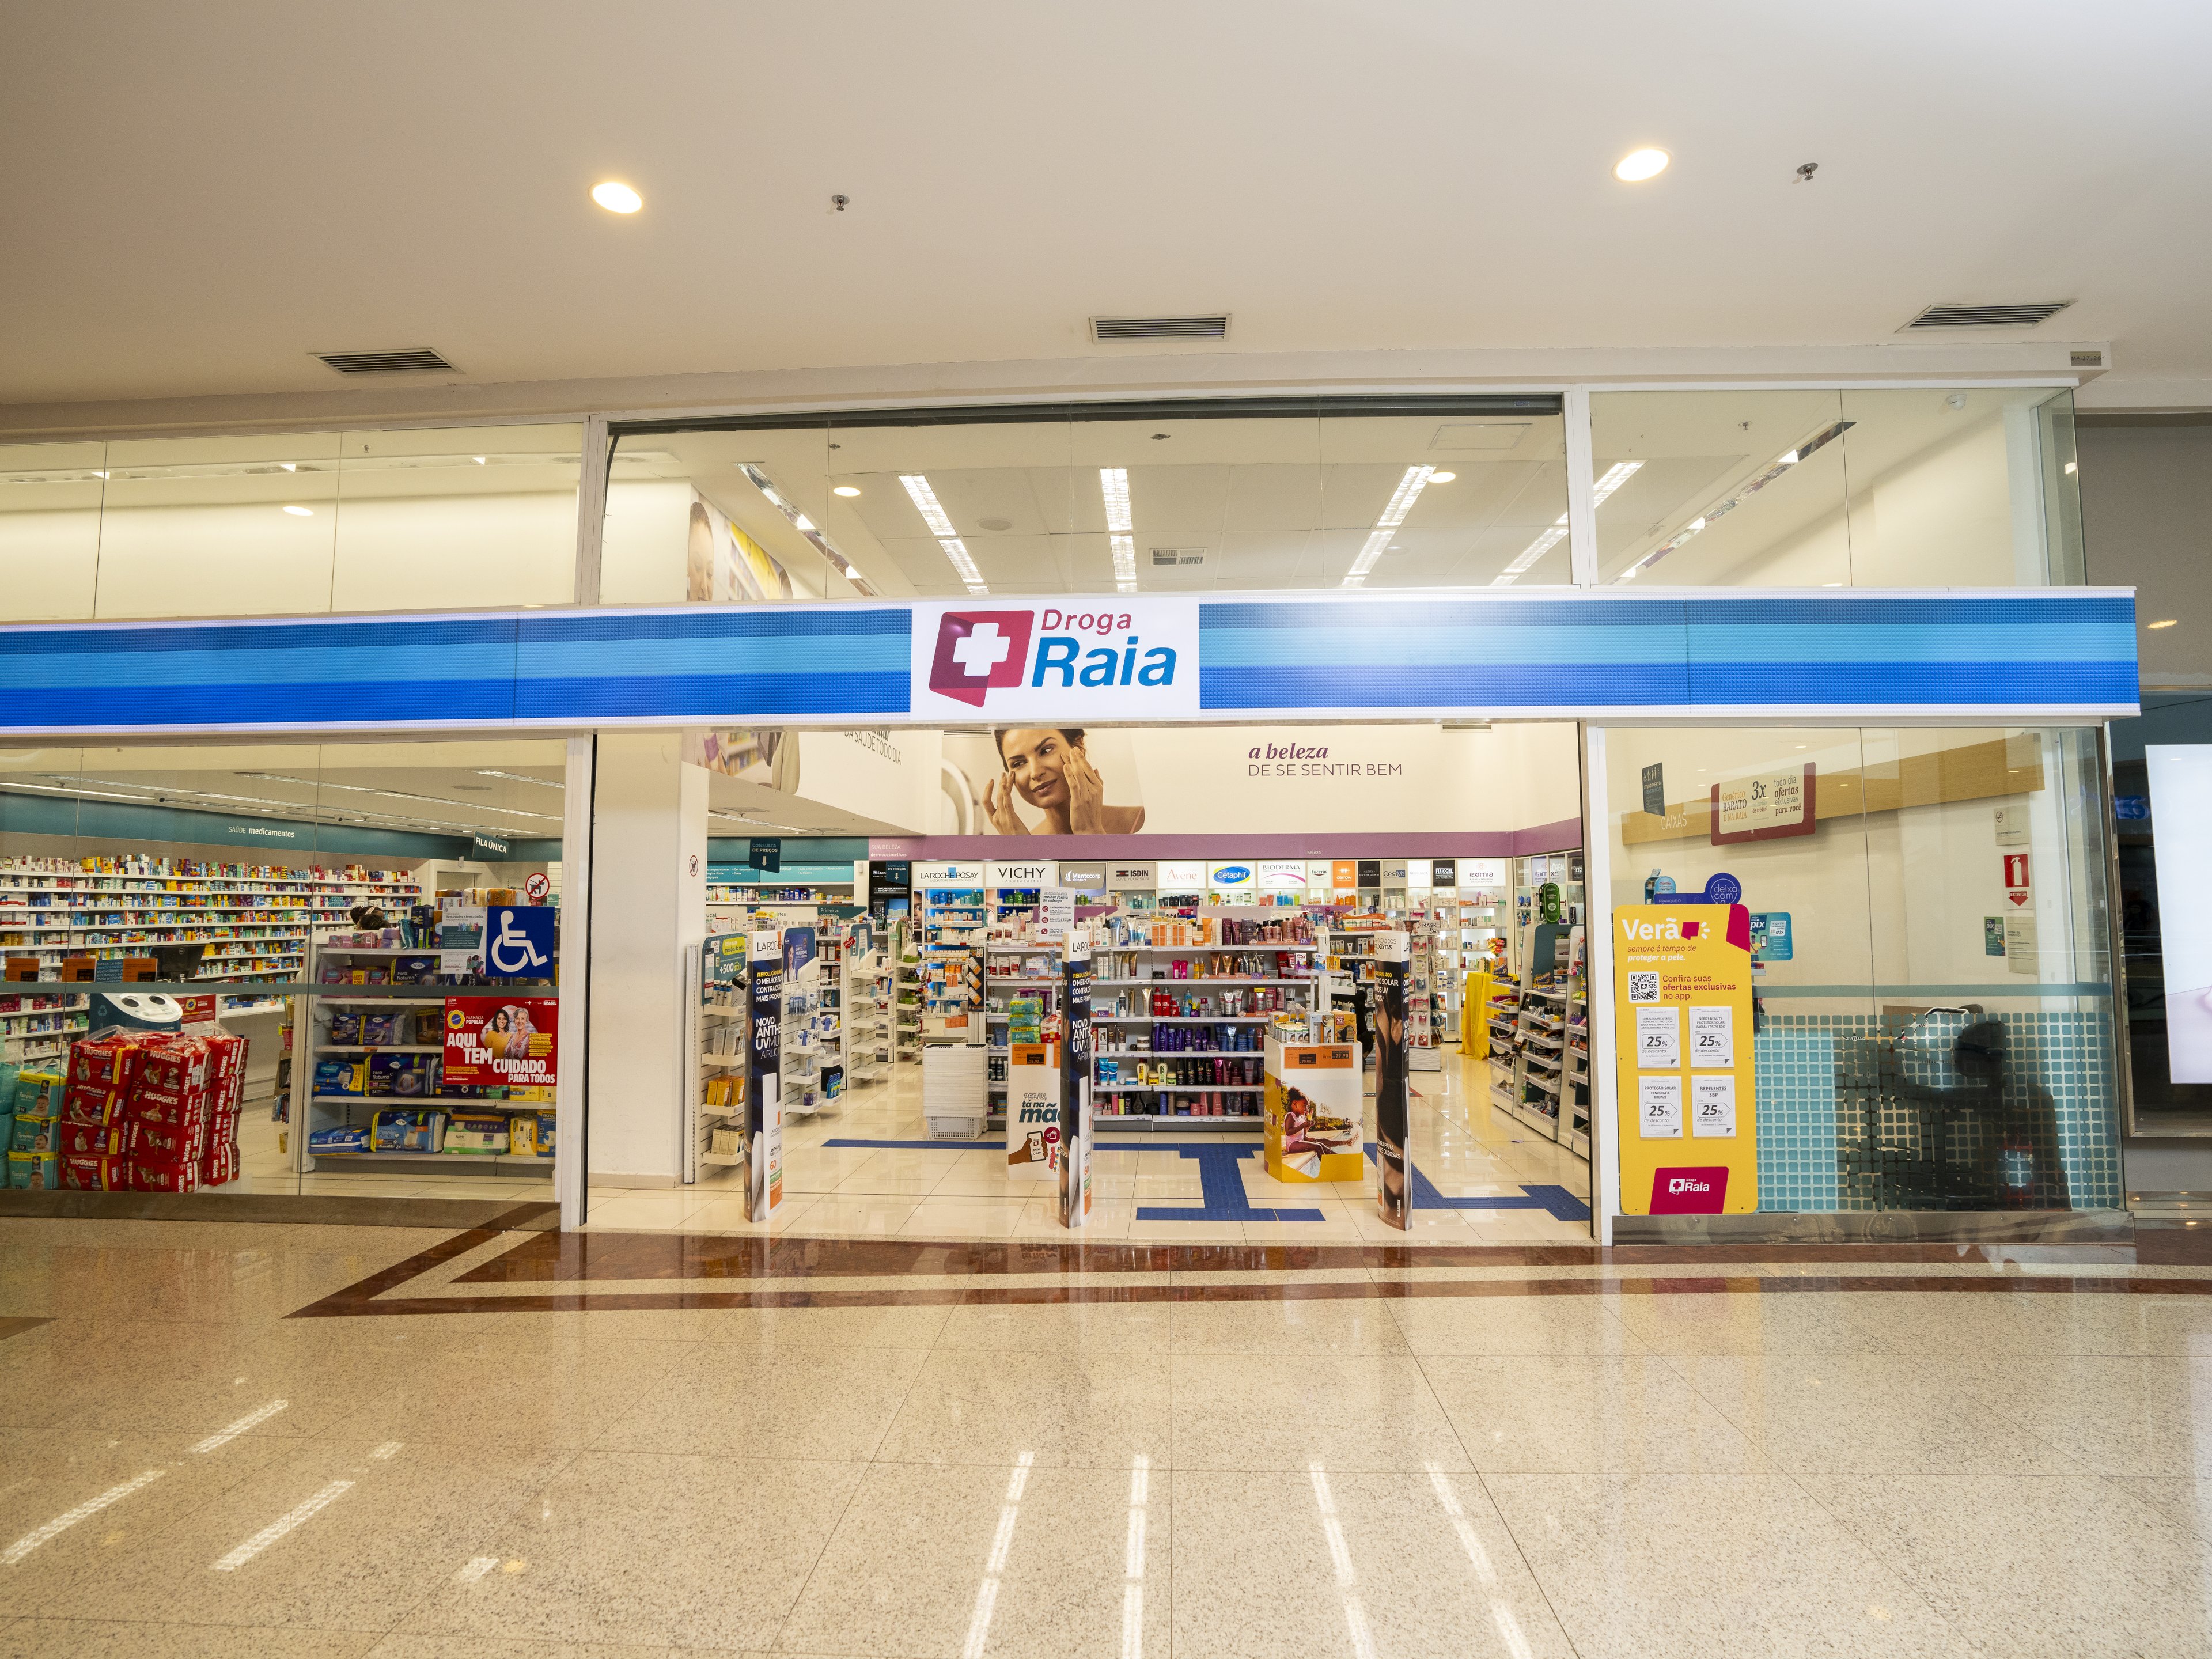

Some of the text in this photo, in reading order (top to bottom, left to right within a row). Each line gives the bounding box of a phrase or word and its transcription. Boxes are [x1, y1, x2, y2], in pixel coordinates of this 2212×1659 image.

[1041, 609, 1131, 635] Droga
[1031, 636, 1176, 687] Raia
[877, 738, 892, 760] TODO
[892, 748, 902, 765] DIA
[1248, 743, 1329, 760] a beleza
[1249, 763, 1402, 777] DE SE SENTIR BEM
[1774, 775, 1796, 787] todo dia
[1722, 790, 1745, 802] Genérico
[1752, 781, 1767, 800] 3x
[1774, 786, 1798, 800] ofertas
[1722, 798, 1747, 812] BARATO
[1775, 796, 1798, 806] exclusivas
[1775, 803, 1801, 816] para você
[1661, 812, 1687, 830] CAIXAS
[1728, 813, 1735, 821] NA
[1735, 810, 1747, 820] RAIA
[228, 826, 295, 838] SAÚDE medicamentos
[475, 836, 507, 854] FILA ÚNICA
[998, 868, 1046, 878] VICHY
[1072, 872, 1101, 882] Mantecorp
[1167, 869, 1197, 880] Avène
[1217, 871, 1247, 880] Cetaphil
[1714, 884, 1737, 893] deixa
[1750, 919, 1766, 930] pix
[757, 941, 767, 952] LA
[1073, 942, 1081, 952] LA
[1627, 945, 1654, 955] sempre
[1662, 945, 1685, 954] tempo
[1627, 954, 1658, 963] proteger
[1667, 953, 1685, 962] pele.
[720, 963, 734, 974] +500
[761, 976, 778, 984] MELHOR
[1381, 978, 1399, 986] SOLAR
[756, 986, 773, 994] CONTRA
[1694, 983, 1736, 991] exclusivas
[1675, 993, 1692, 1001] app.
[756, 1016, 775, 1027] NOVO
[1073, 1018, 1088, 1029] NOVO
[446, 1033, 477, 1049] AQUI
[1646, 1036, 1668, 1047] 25%
[1699, 1036, 1721, 1047] 25%
[84, 1047, 113, 1057] HUGGIES
[150, 1050, 181, 1064] HUGGIES
[463, 1047, 493, 1065] TEM
[218, 1055, 228, 1078] HUGGIES
[493, 1059, 546, 1074] CUIDADO
[507, 1074, 555, 1084] PARA TODOS
[144, 1090, 179, 1105] HUGGIES
[217, 1090, 226, 1112] HUGGIES
[1023, 1093, 1047, 1101] PEDIU,
[1022, 1100, 1032, 1108] tá
[1649, 1105, 1671, 1116] 25%
[1702, 1105, 1724, 1116] 25%
[130, 1121, 140, 1148] HUGGIES
[182, 1140, 192, 1162] HUGGIES
[1384, 1142, 1394, 1150] PARA
[1383, 1149, 1401, 1159] OLEOSAS
[70, 1158, 99, 1167] HUGGIES
[770, 1159, 777, 1171] 60
[1685, 1182, 1710, 1192] Raia
